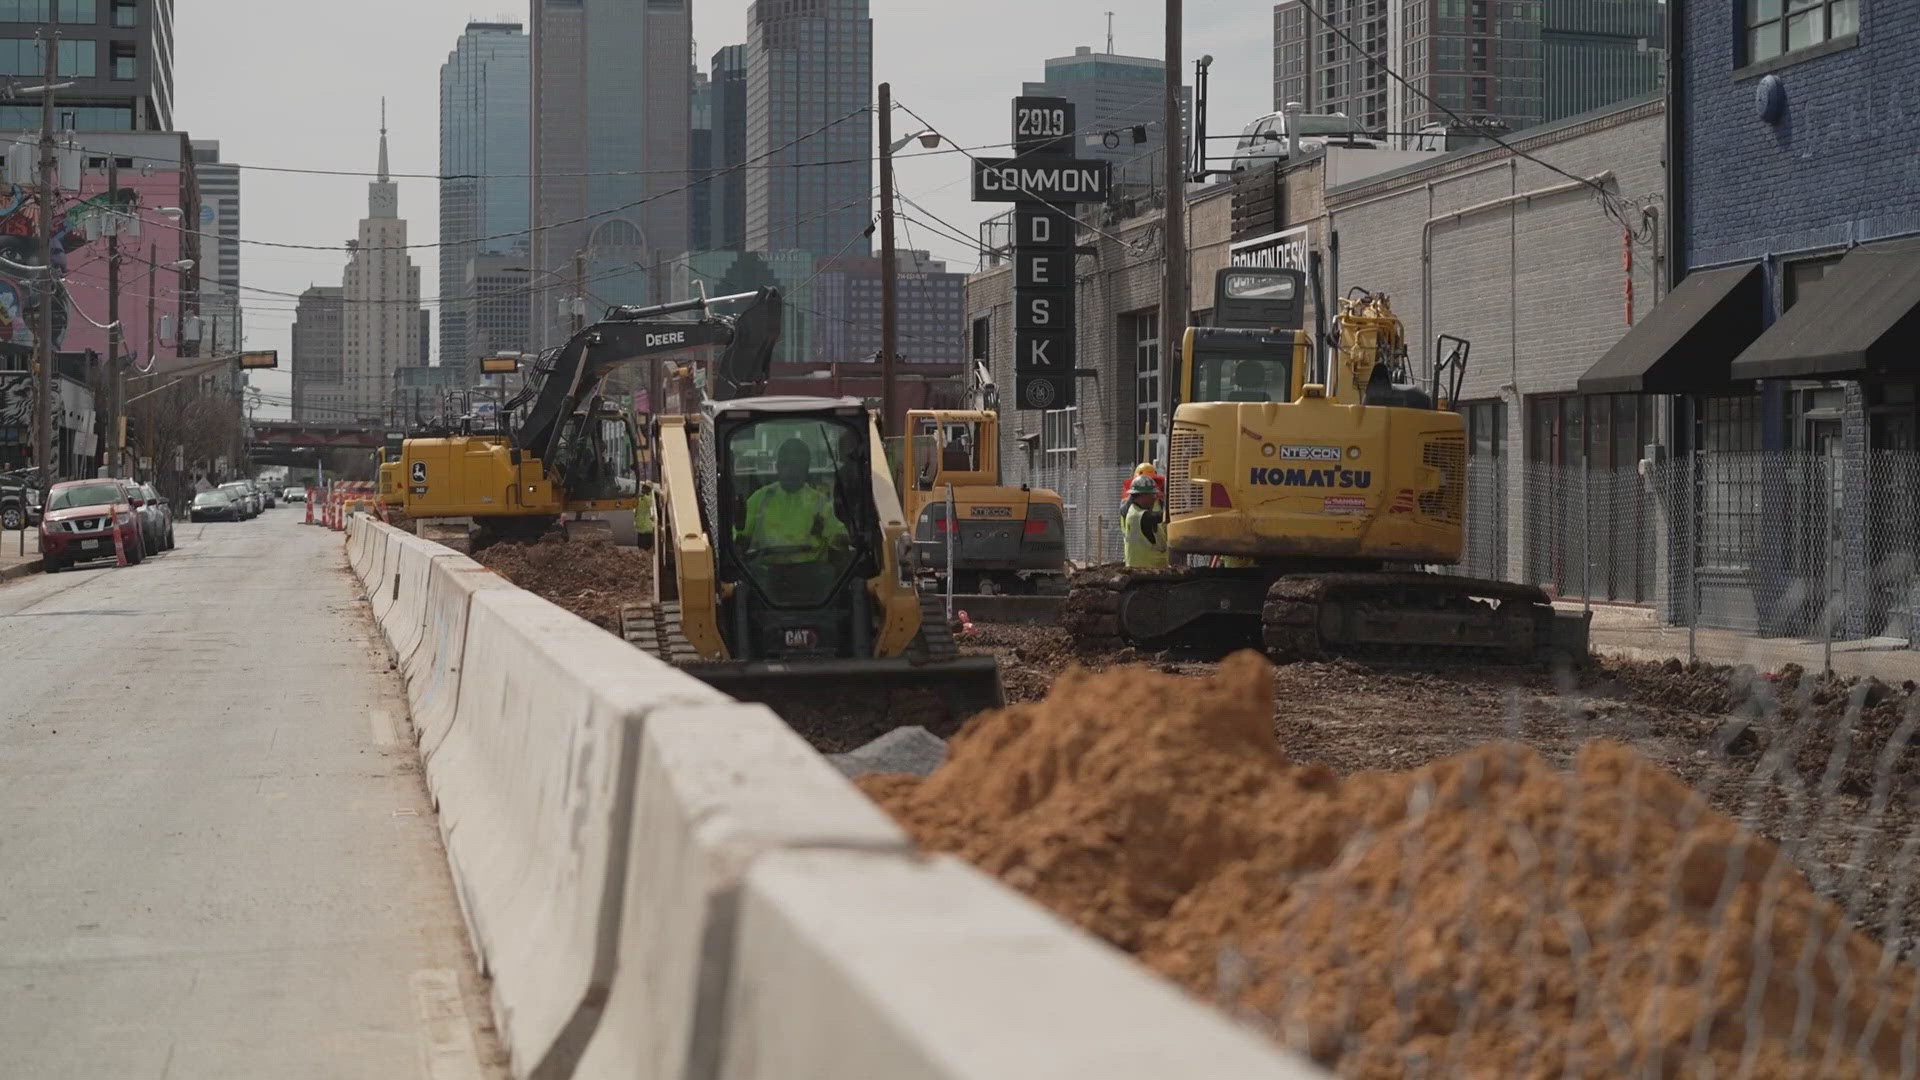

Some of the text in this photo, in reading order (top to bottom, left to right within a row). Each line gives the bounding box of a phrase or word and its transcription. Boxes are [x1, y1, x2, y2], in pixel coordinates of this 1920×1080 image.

[1018, 108, 1064, 135] 2919
[983, 168, 1099, 192] COMMON
[1276, 240, 1306, 273] DESK
[1031, 217, 1050, 365] DESK
[645, 332, 685, 347] DEERE
[1281, 447, 1341, 459] NTEXCON
[1250, 467, 1371, 488] KOMATSU
[785, 630, 809, 646] CAT
